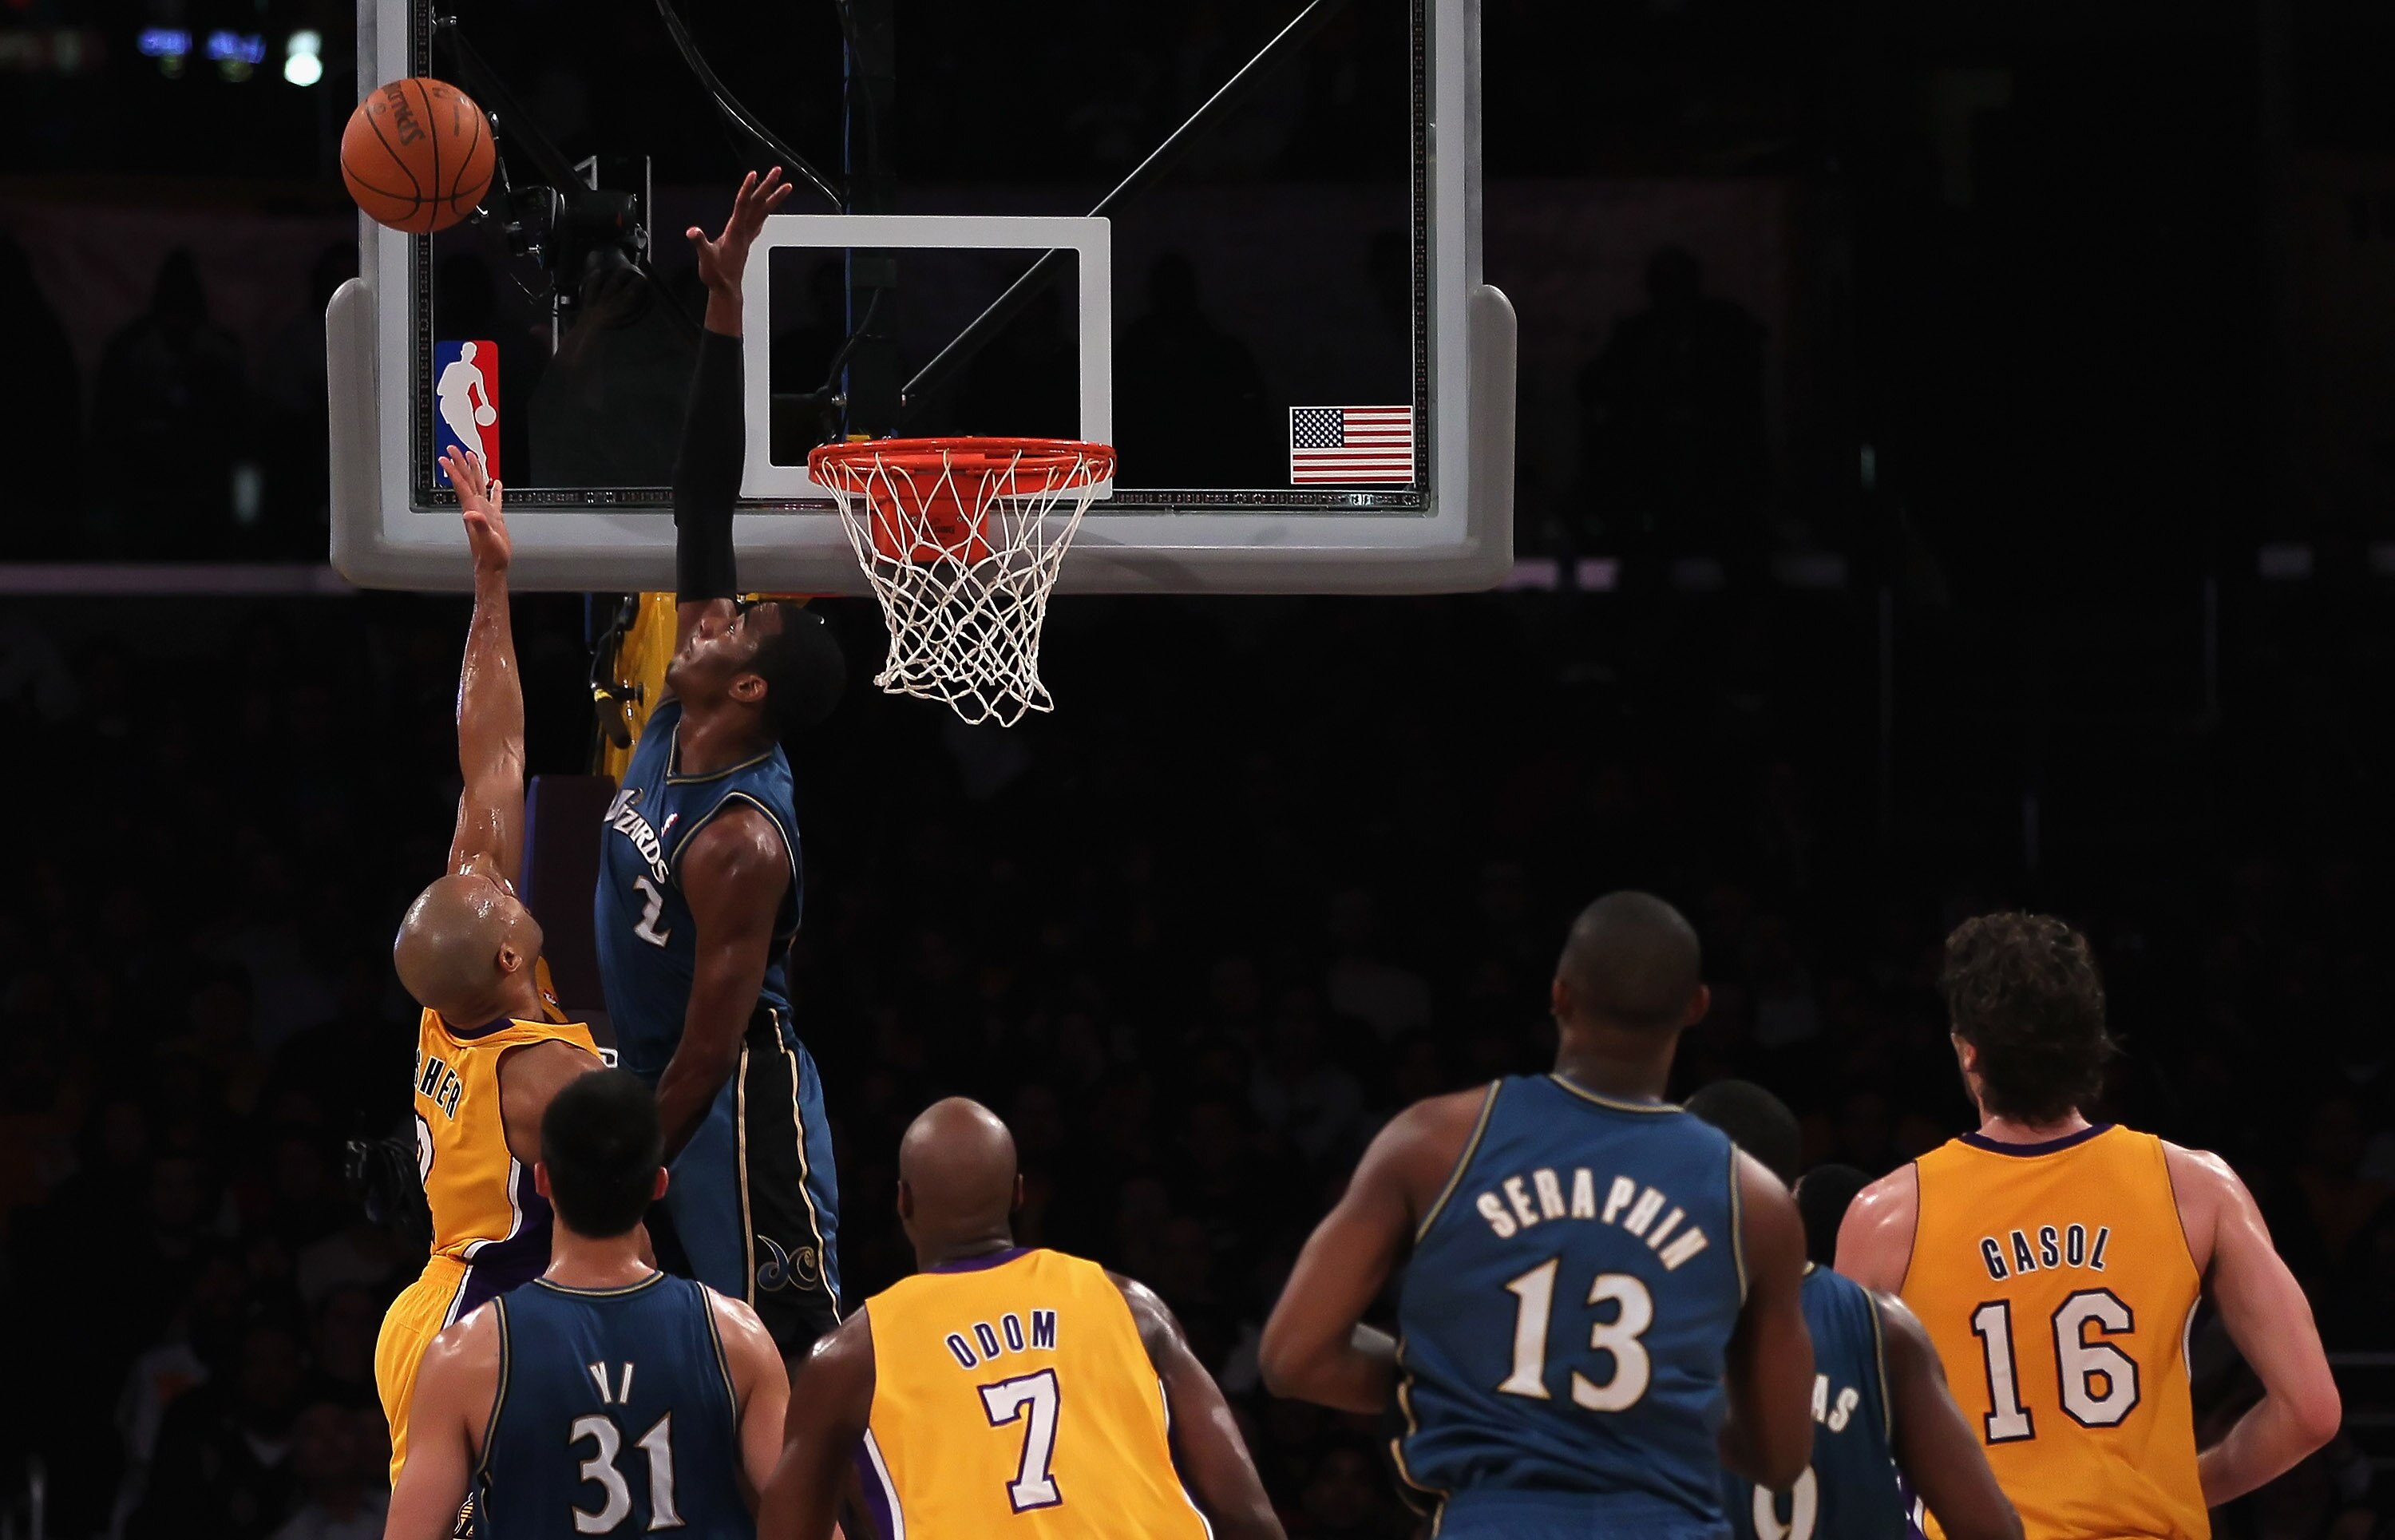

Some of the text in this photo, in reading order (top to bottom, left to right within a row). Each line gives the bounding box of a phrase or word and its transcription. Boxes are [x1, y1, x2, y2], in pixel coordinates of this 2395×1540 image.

[382, 81, 426, 145] SPALD
[633, 875, 671, 948] 2
[1476, 1167, 1709, 1271] SERAPHIN
[1979, 1223, 2109, 1281] GASOL
[945, 1308, 1057, 1370] ODOM
[1496, 1256, 1654, 1412] 13
[1969, 1287, 2140, 1446] 16
[589, 1360, 634, 1404] YI
[568, 1411, 687, 1534] 31
[976, 1367, 1063, 1515] 7
